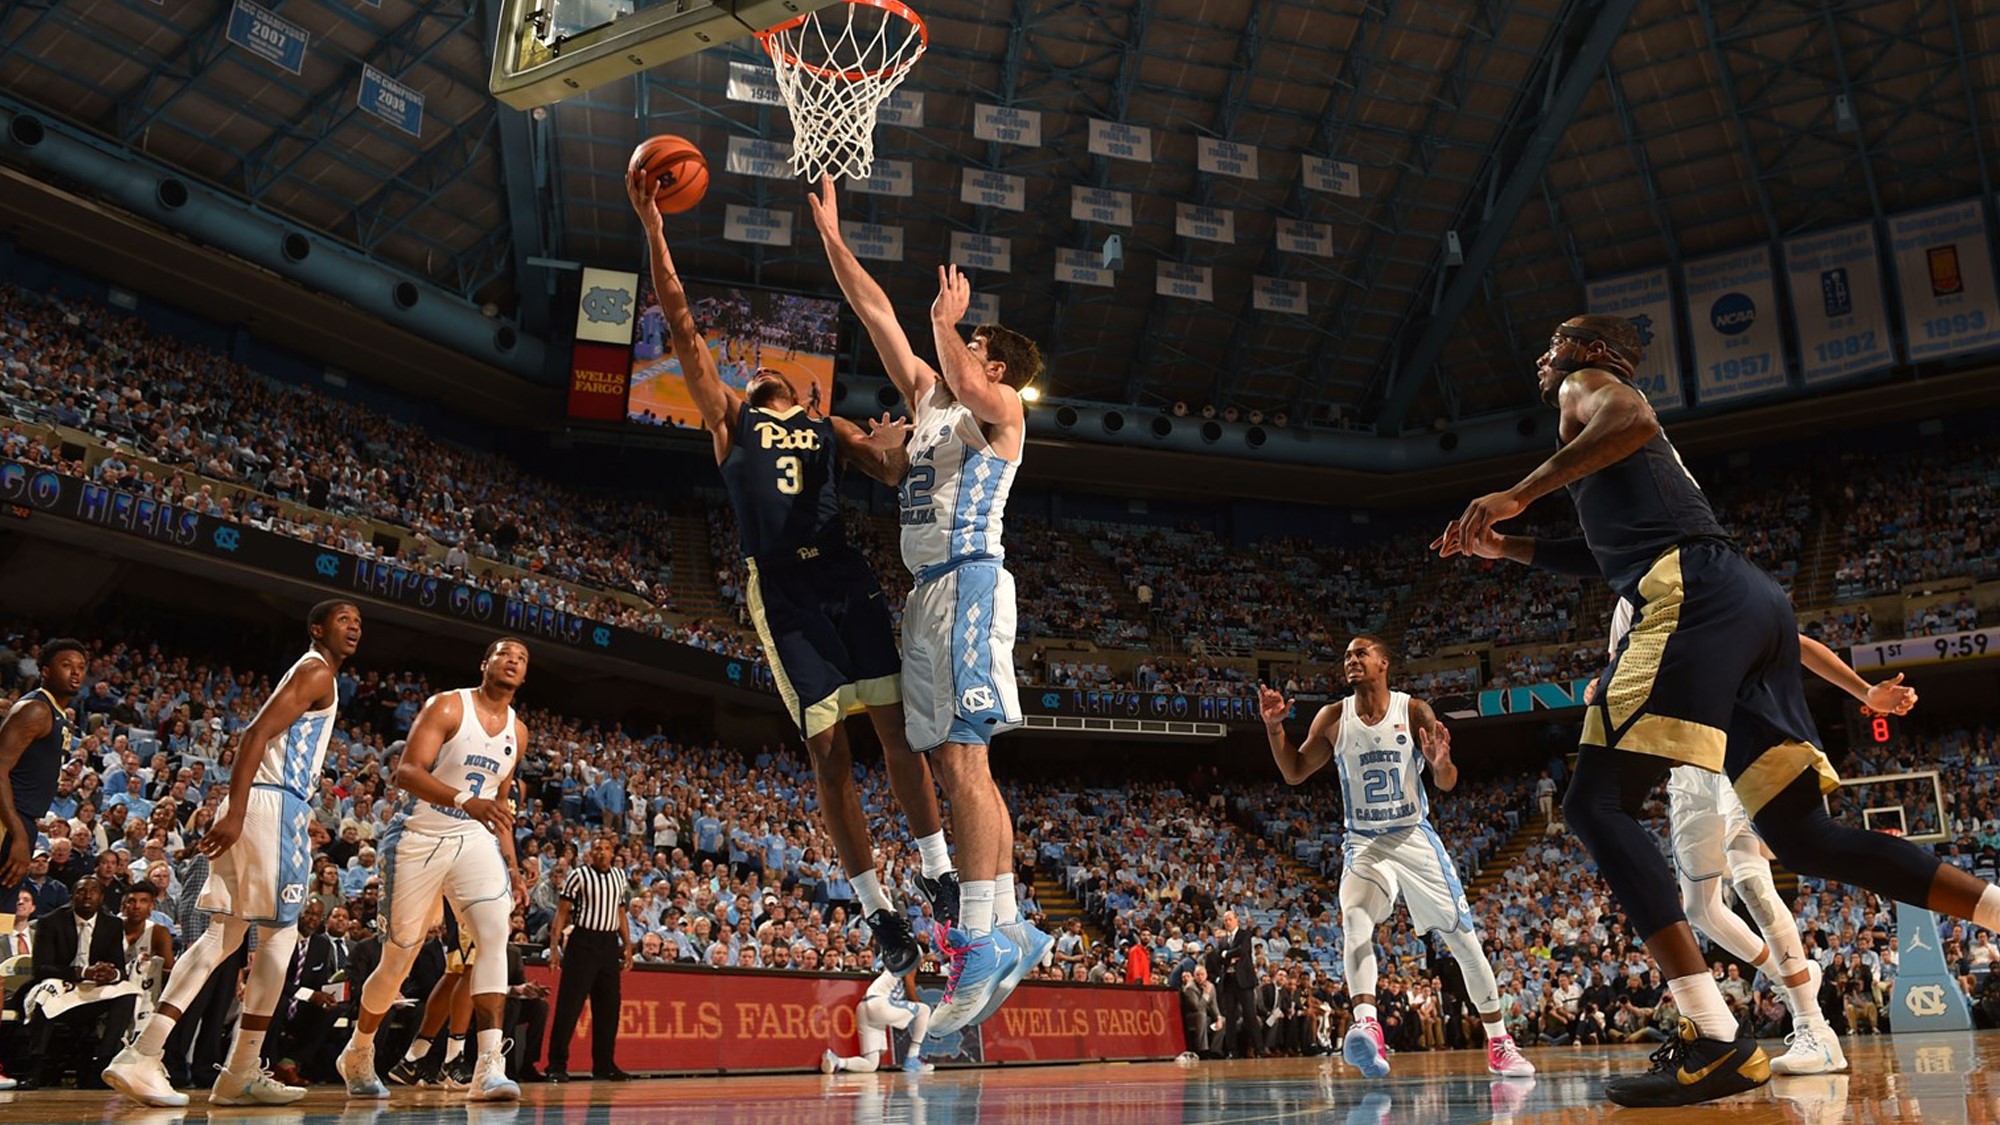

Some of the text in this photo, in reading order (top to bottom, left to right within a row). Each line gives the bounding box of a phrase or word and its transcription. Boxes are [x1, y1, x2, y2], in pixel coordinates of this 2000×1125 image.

[250, 20, 286, 48] 2007
[377, 89, 406, 112] 2008
[996, 127, 1021, 141] 1967
[1715, 309, 1756, 328] NCAA
[1923, 310, 1986, 338] 1993
[1814, 331, 1876, 362] 1982
[574, 369, 625, 386] WELLS
[1709, 352, 1770, 383] 1957
[574, 380, 624, 396] FARGO
[753, 420, 821, 451] Pitt
[775, 455, 804, 496] 3
[0, 461, 199, 546] GO HEELS
[796, 546, 821, 560] Pitt
[353, 558, 439, 608] LET'S
[448, 584, 493, 622] GO
[503, 597, 583, 645] HEELS
[1934, 633, 1989, 659] 9:59
[1073, 690, 1140, 717] LET'S
[1150, 693, 1188, 718] GO
[1198, 696, 1261, 720] HEEL
[1872, 717, 1890, 742] 8
[464, 754, 501, 774] NORTH
[1359, 750, 1401, 766] NORTH
[465, 772, 486, 799] 3
[1363, 768, 1404, 803] 21
[1355, 802, 1417, 821] CAROLINA
[735, 1002, 857, 1039] FARGO
[1001, 1007, 1166, 1037] WELLS FARGO
